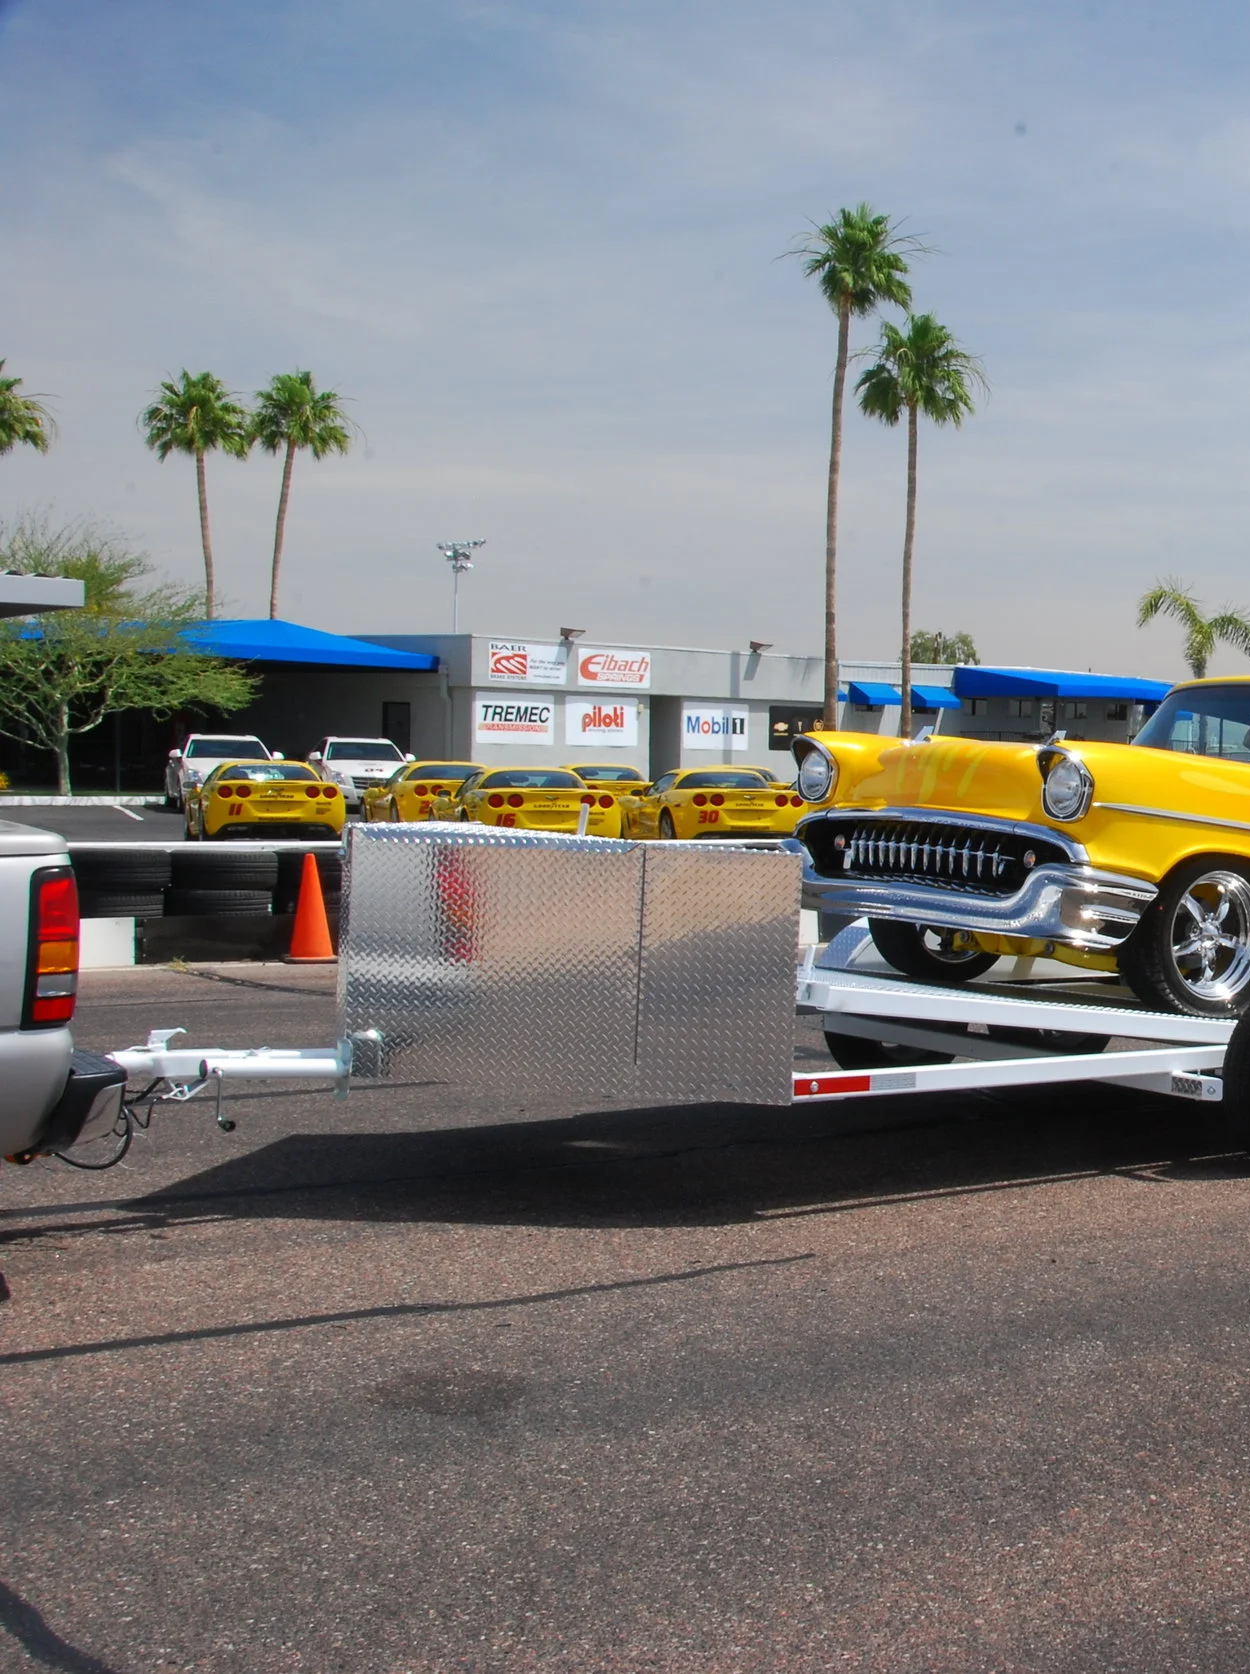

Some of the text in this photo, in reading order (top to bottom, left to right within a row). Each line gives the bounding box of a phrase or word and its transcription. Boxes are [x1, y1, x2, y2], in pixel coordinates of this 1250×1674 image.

[491, 643, 527, 652] BAER
[580, 654, 649, 680] Eibach
[598, 673, 640, 683] SPRINGS
[482, 704, 551, 723] TREMEC
[582, 705, 624, 732] piloti
[687, 716, 729, 735] Mobil
[228, 803, 244, 816] 11
[495, 813, 516, 827] 16
[698, 810, 719, 824] 30
